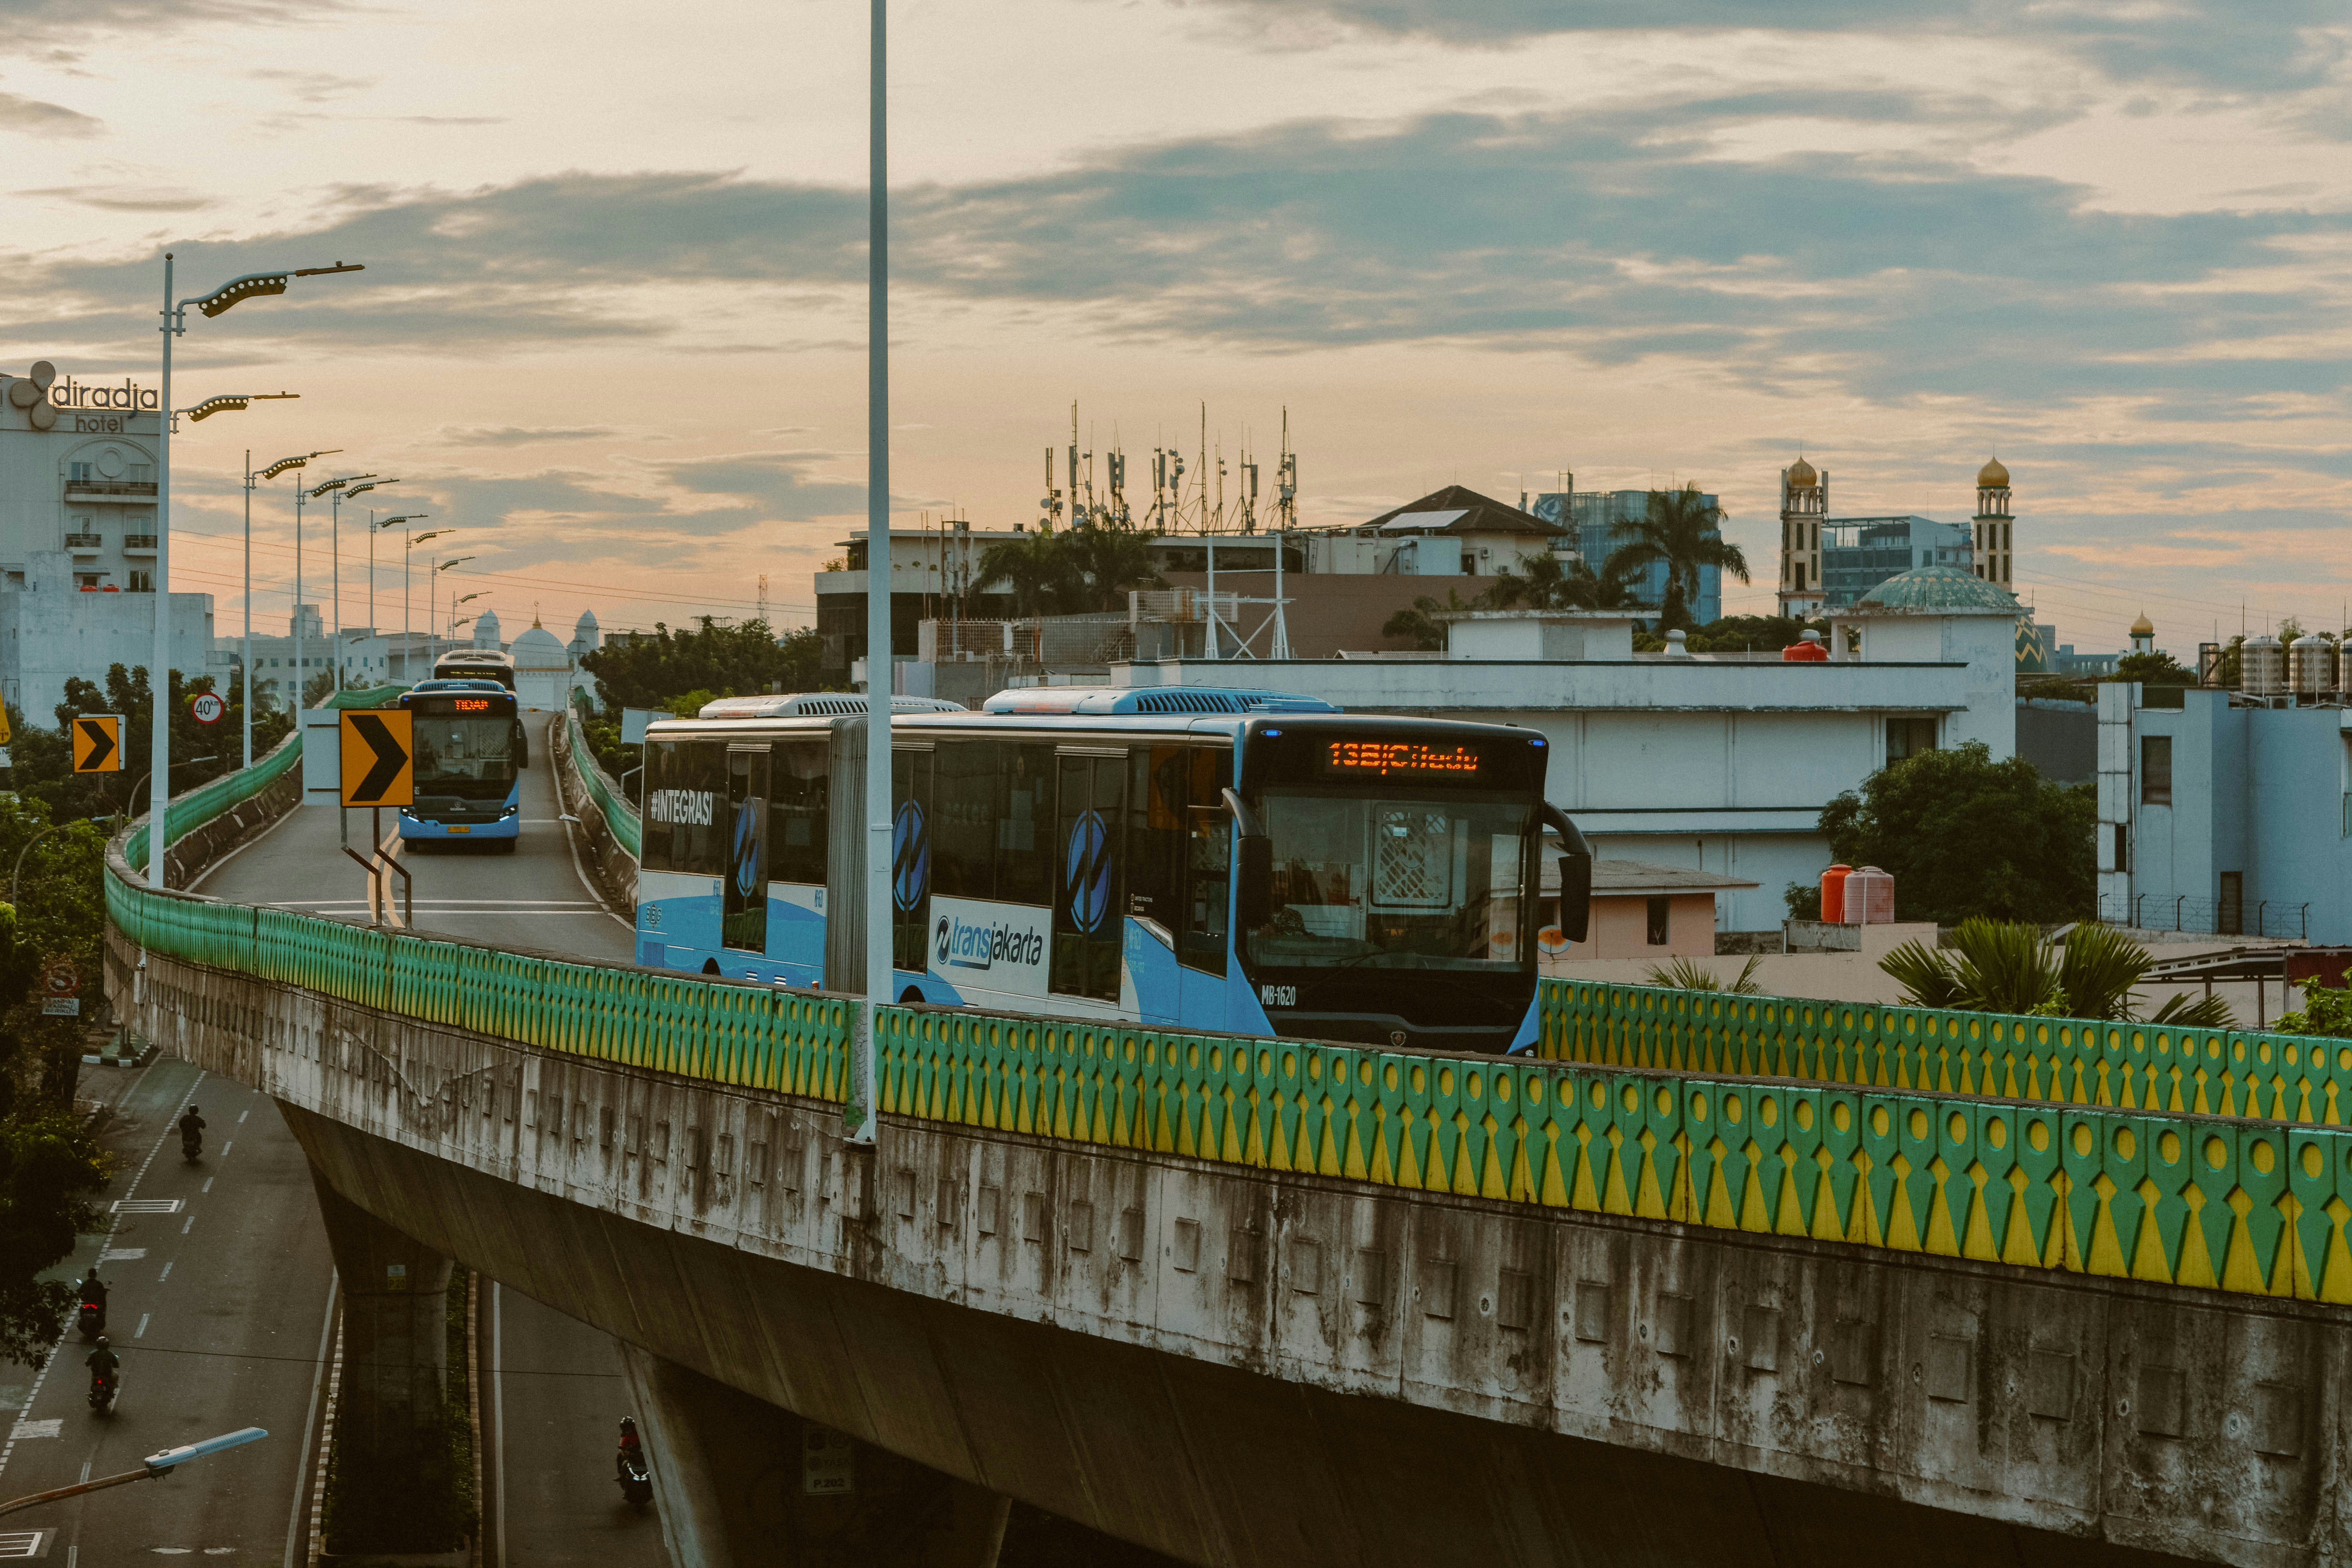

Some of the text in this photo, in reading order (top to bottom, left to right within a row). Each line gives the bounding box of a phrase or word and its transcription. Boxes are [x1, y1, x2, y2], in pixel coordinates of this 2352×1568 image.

[52, 376, 158, 419] diradja
[75, 414, 124, 433] hotel
[651, 789, 712, 826] #INTEGRASI
[951, 916, 1043, 969] transjakarta
[1261, 985, 1296, 1006] MB-1620
[813, 1478, 845, 1488] P.202
